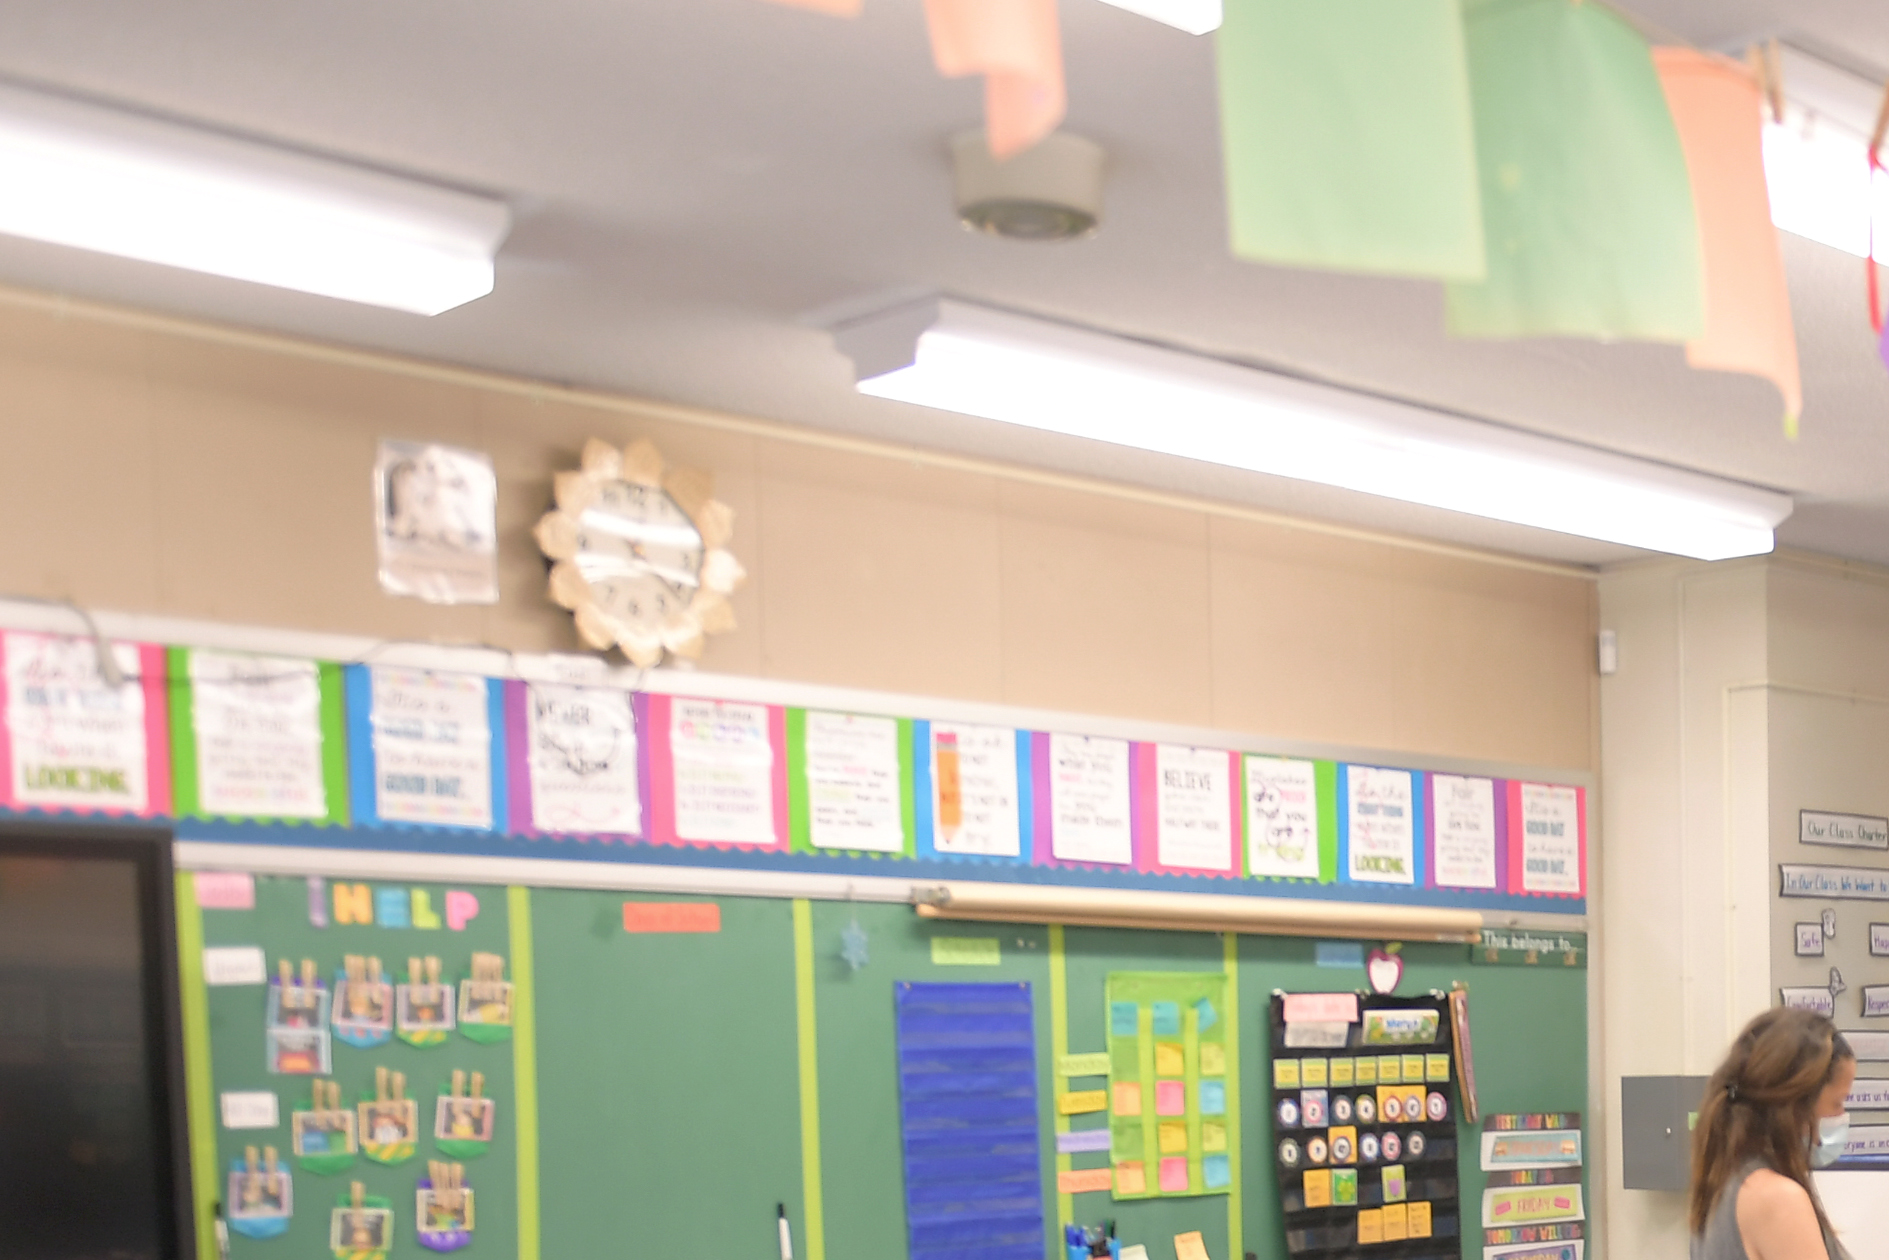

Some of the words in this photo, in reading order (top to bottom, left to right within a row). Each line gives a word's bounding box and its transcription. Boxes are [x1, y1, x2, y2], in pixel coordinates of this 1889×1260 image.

[1808, 820, 1825, 836] Our
[1830, 823, 1854, 839] Class
[1858, 824, 1887, 842] Charter
[1800, 875, 1812, 889] Our
[1815, 875, 1837, 890] Class
[1880, 879, 1888, 892] to
[1482, 930, 1508, 950] This
[1802, 933, 1820, 948] Safe
